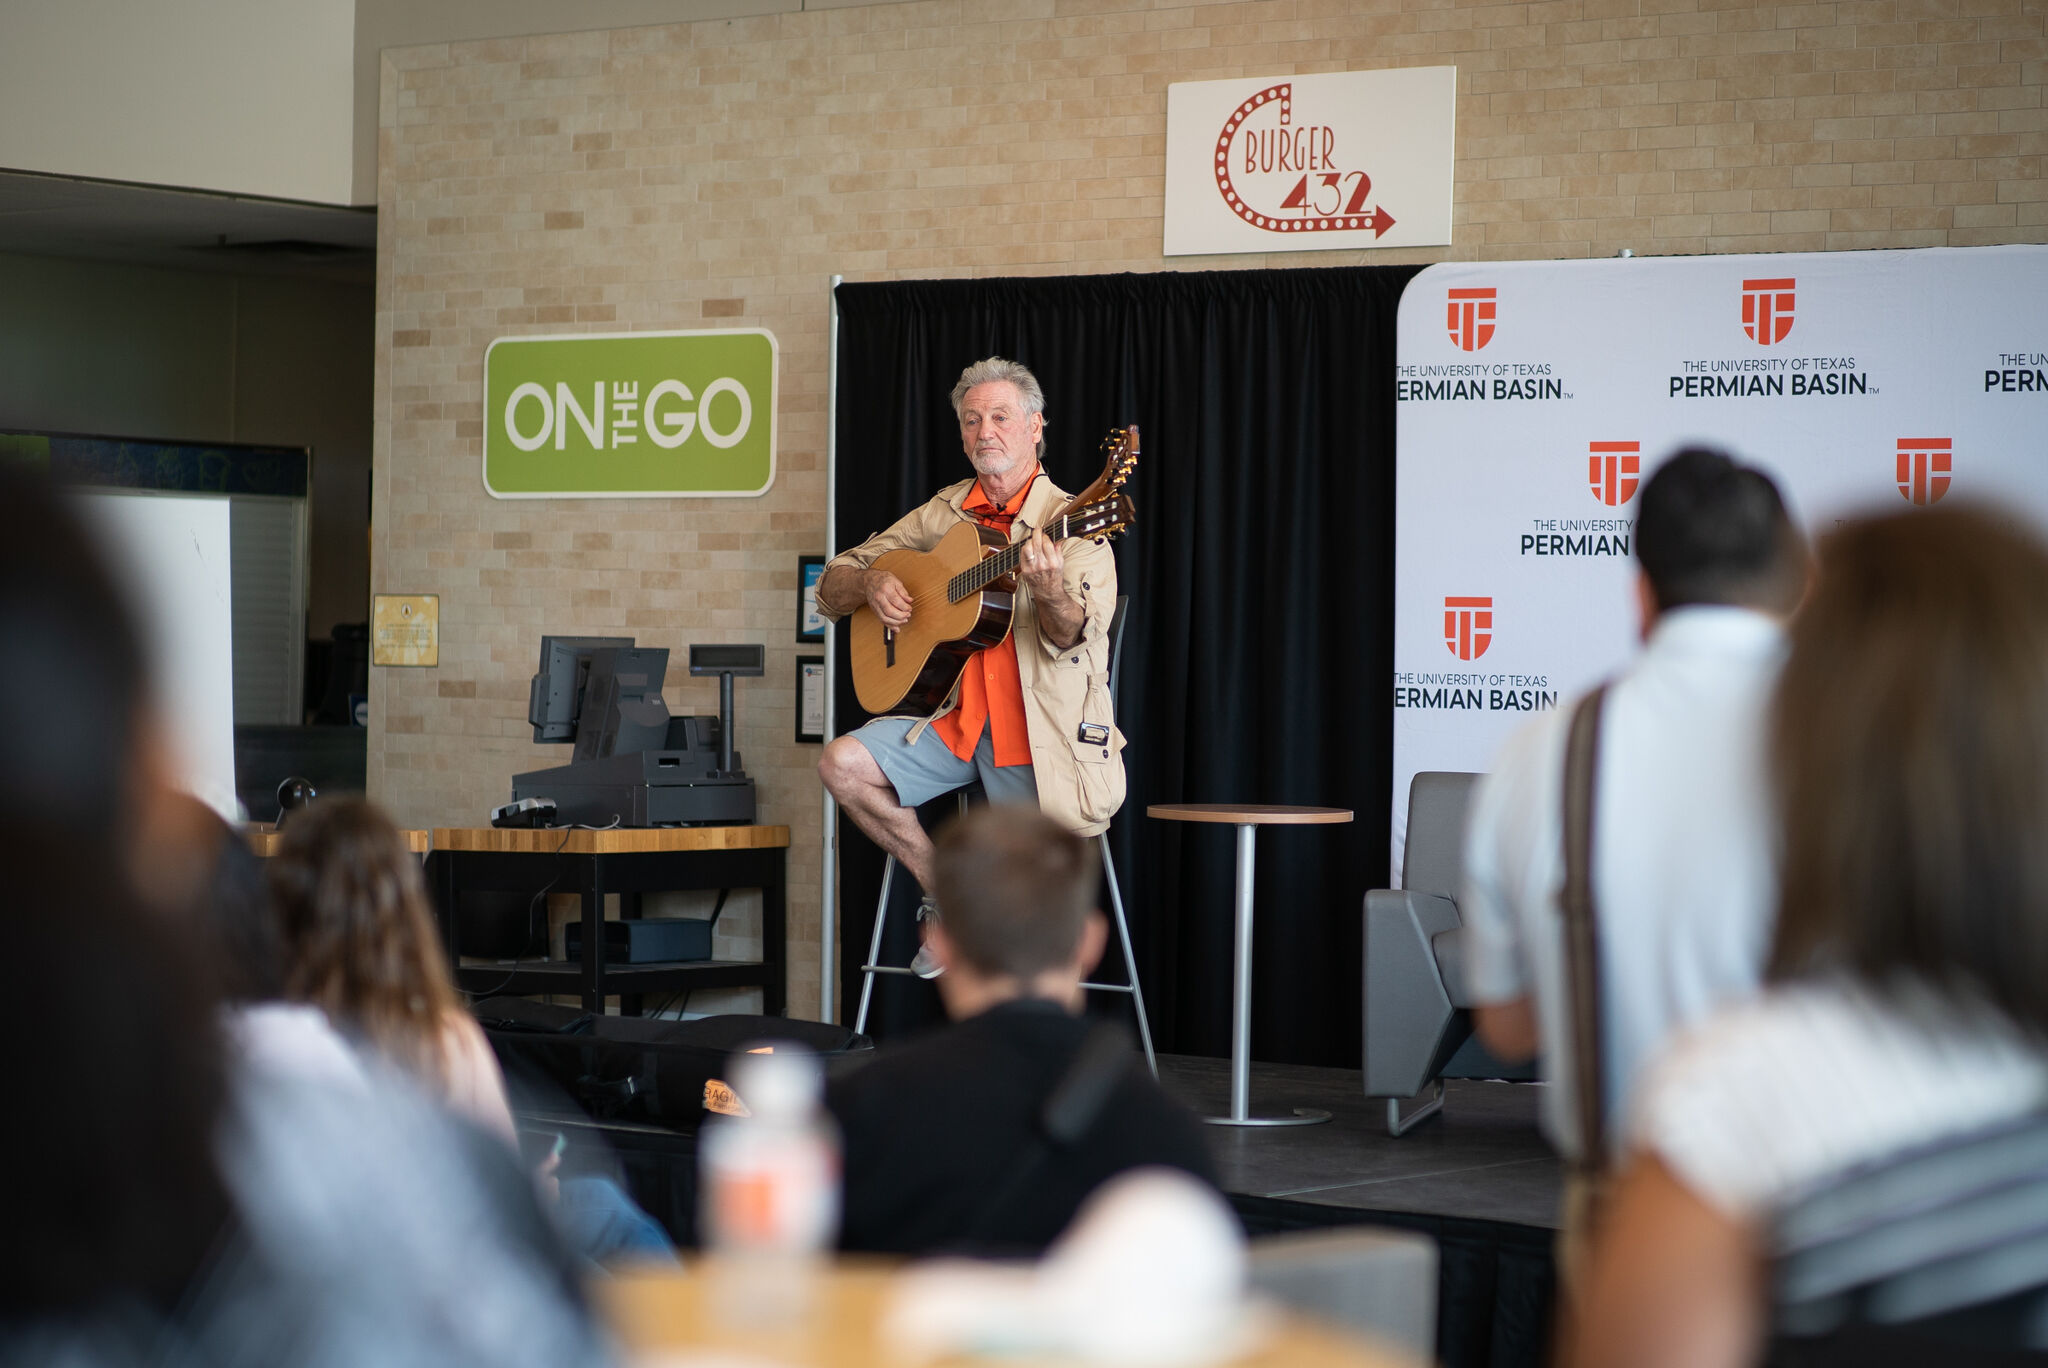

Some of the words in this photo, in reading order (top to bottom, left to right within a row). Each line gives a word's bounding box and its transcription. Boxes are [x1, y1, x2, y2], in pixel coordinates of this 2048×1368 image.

[1245, 125, 1336, 175] BURGER
[1279, 170, 1372, 217] 432
[1419, 364, 1490, 377] UNIVERSITY
[1492, 364, 1510, 376] OF
[1512, 363, 1552, 376] TEXAS
[1682, 360, 1708, 373] THE
[1711, 358, 1788, 372] UNIVERSITY
[1791, 357, 1810, 371] OF
[1812, 356, 1856, 370] TEXAS
[1998, 353, 2027, 366] THE
[1397, 379, 1486, 401] ERMIAN
[1493, 378, 1562, 400] BASIN
[1669, 374, 1784, 398] PERMIAN
[1792, 372, 1867, 396] BASIN
[1984, 369, 2048, 393] PERM
[504, 380, 605, 452] ON
[611, 380, 639, 450] THE
[643, 376, 752, 449] GO
[1533, 519, 1557, 532] THE
[1560, 519, 1634, 532] UNIVERSITY
[1520, 534, 1630, 556] PERMIAN
[1416, 673, 1487, 686] UNIVERSITY
[1489, 674, 1506, 686] OF
[1508, 675, 1548, 688] TEXAS
[1394, 687, 1483, 710] ERMIAN
[1489, 689, 1558, 711] BASIN
